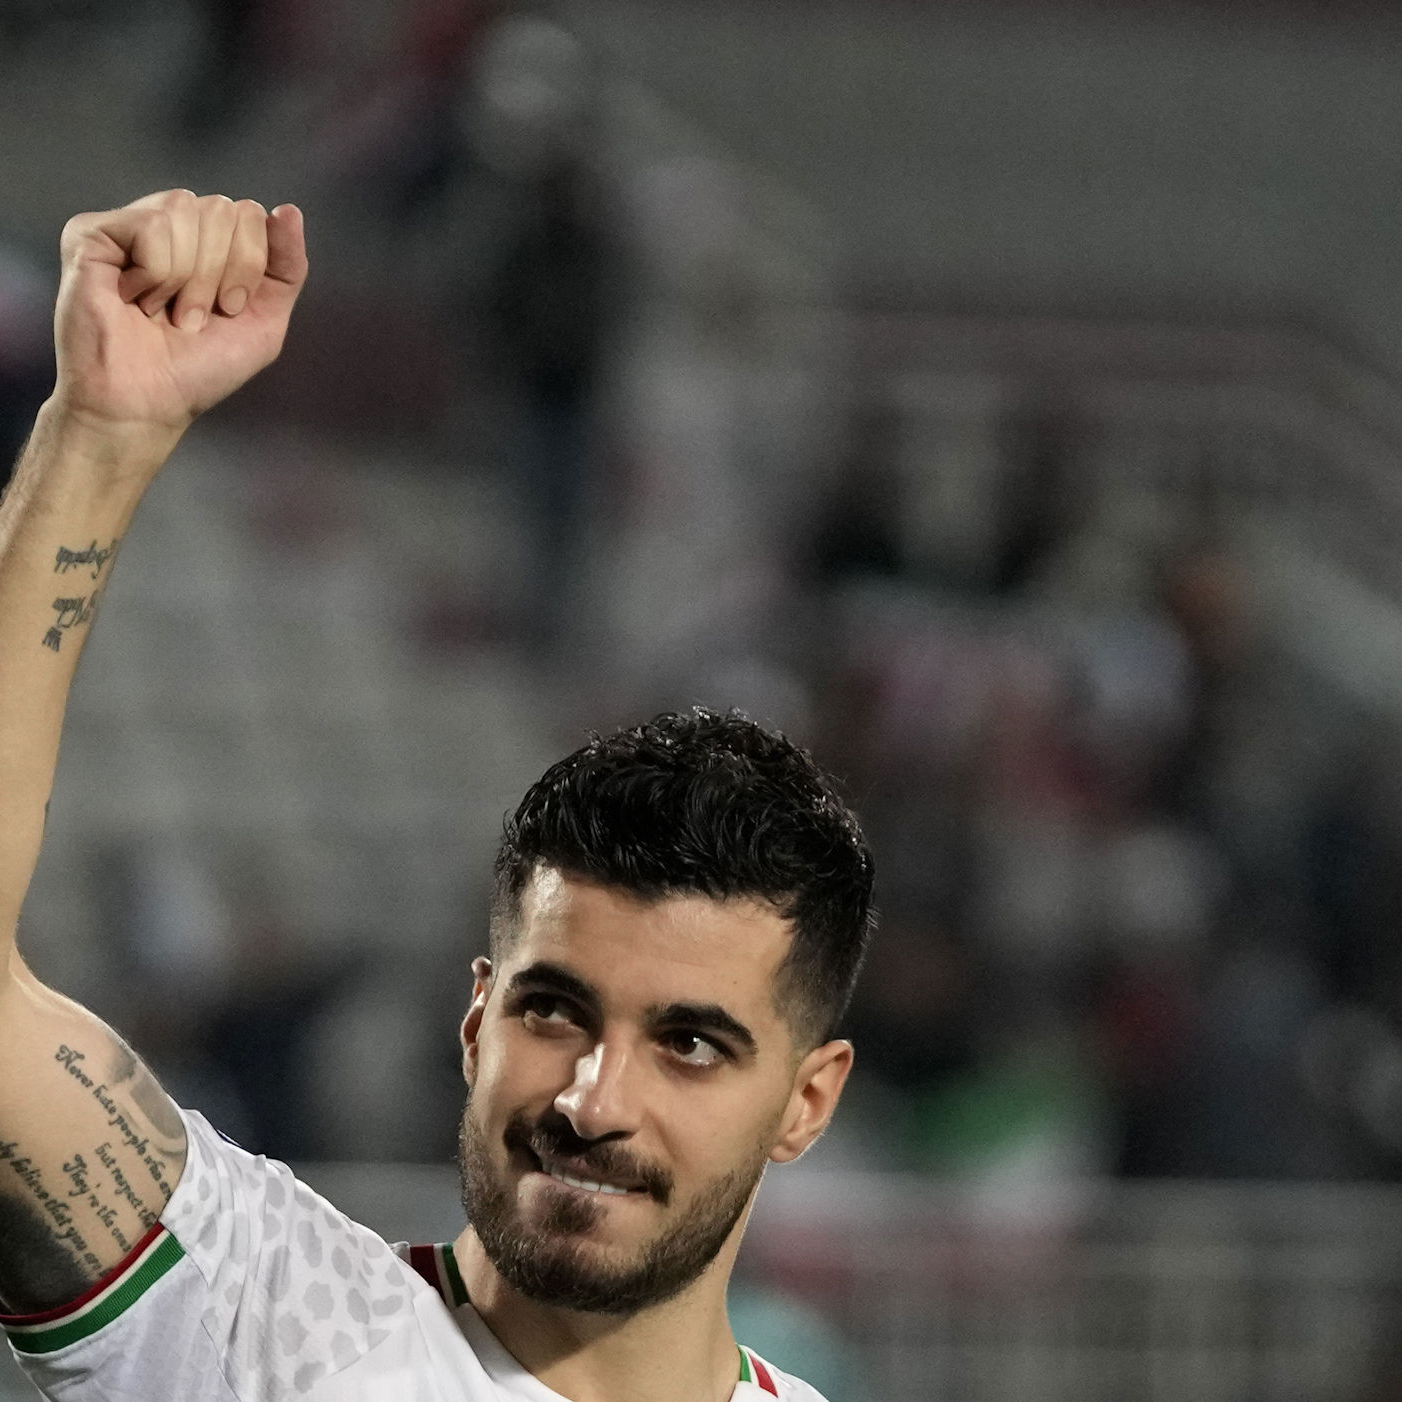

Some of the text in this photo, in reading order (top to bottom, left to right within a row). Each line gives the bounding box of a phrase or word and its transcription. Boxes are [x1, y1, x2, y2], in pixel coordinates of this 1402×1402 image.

[54, 1044, 94, 1088] Never
[92, 1084, 117, 1115] hate
[108, 1114, 149, 1156] people
[144, 1155, 166, 1181] who
[95, 1141, 117, 1169] but
[110, 1167, 143, 1209] respect
[44, 1198, 73, 1227] that
[97, 1205, 118, 1229] the
